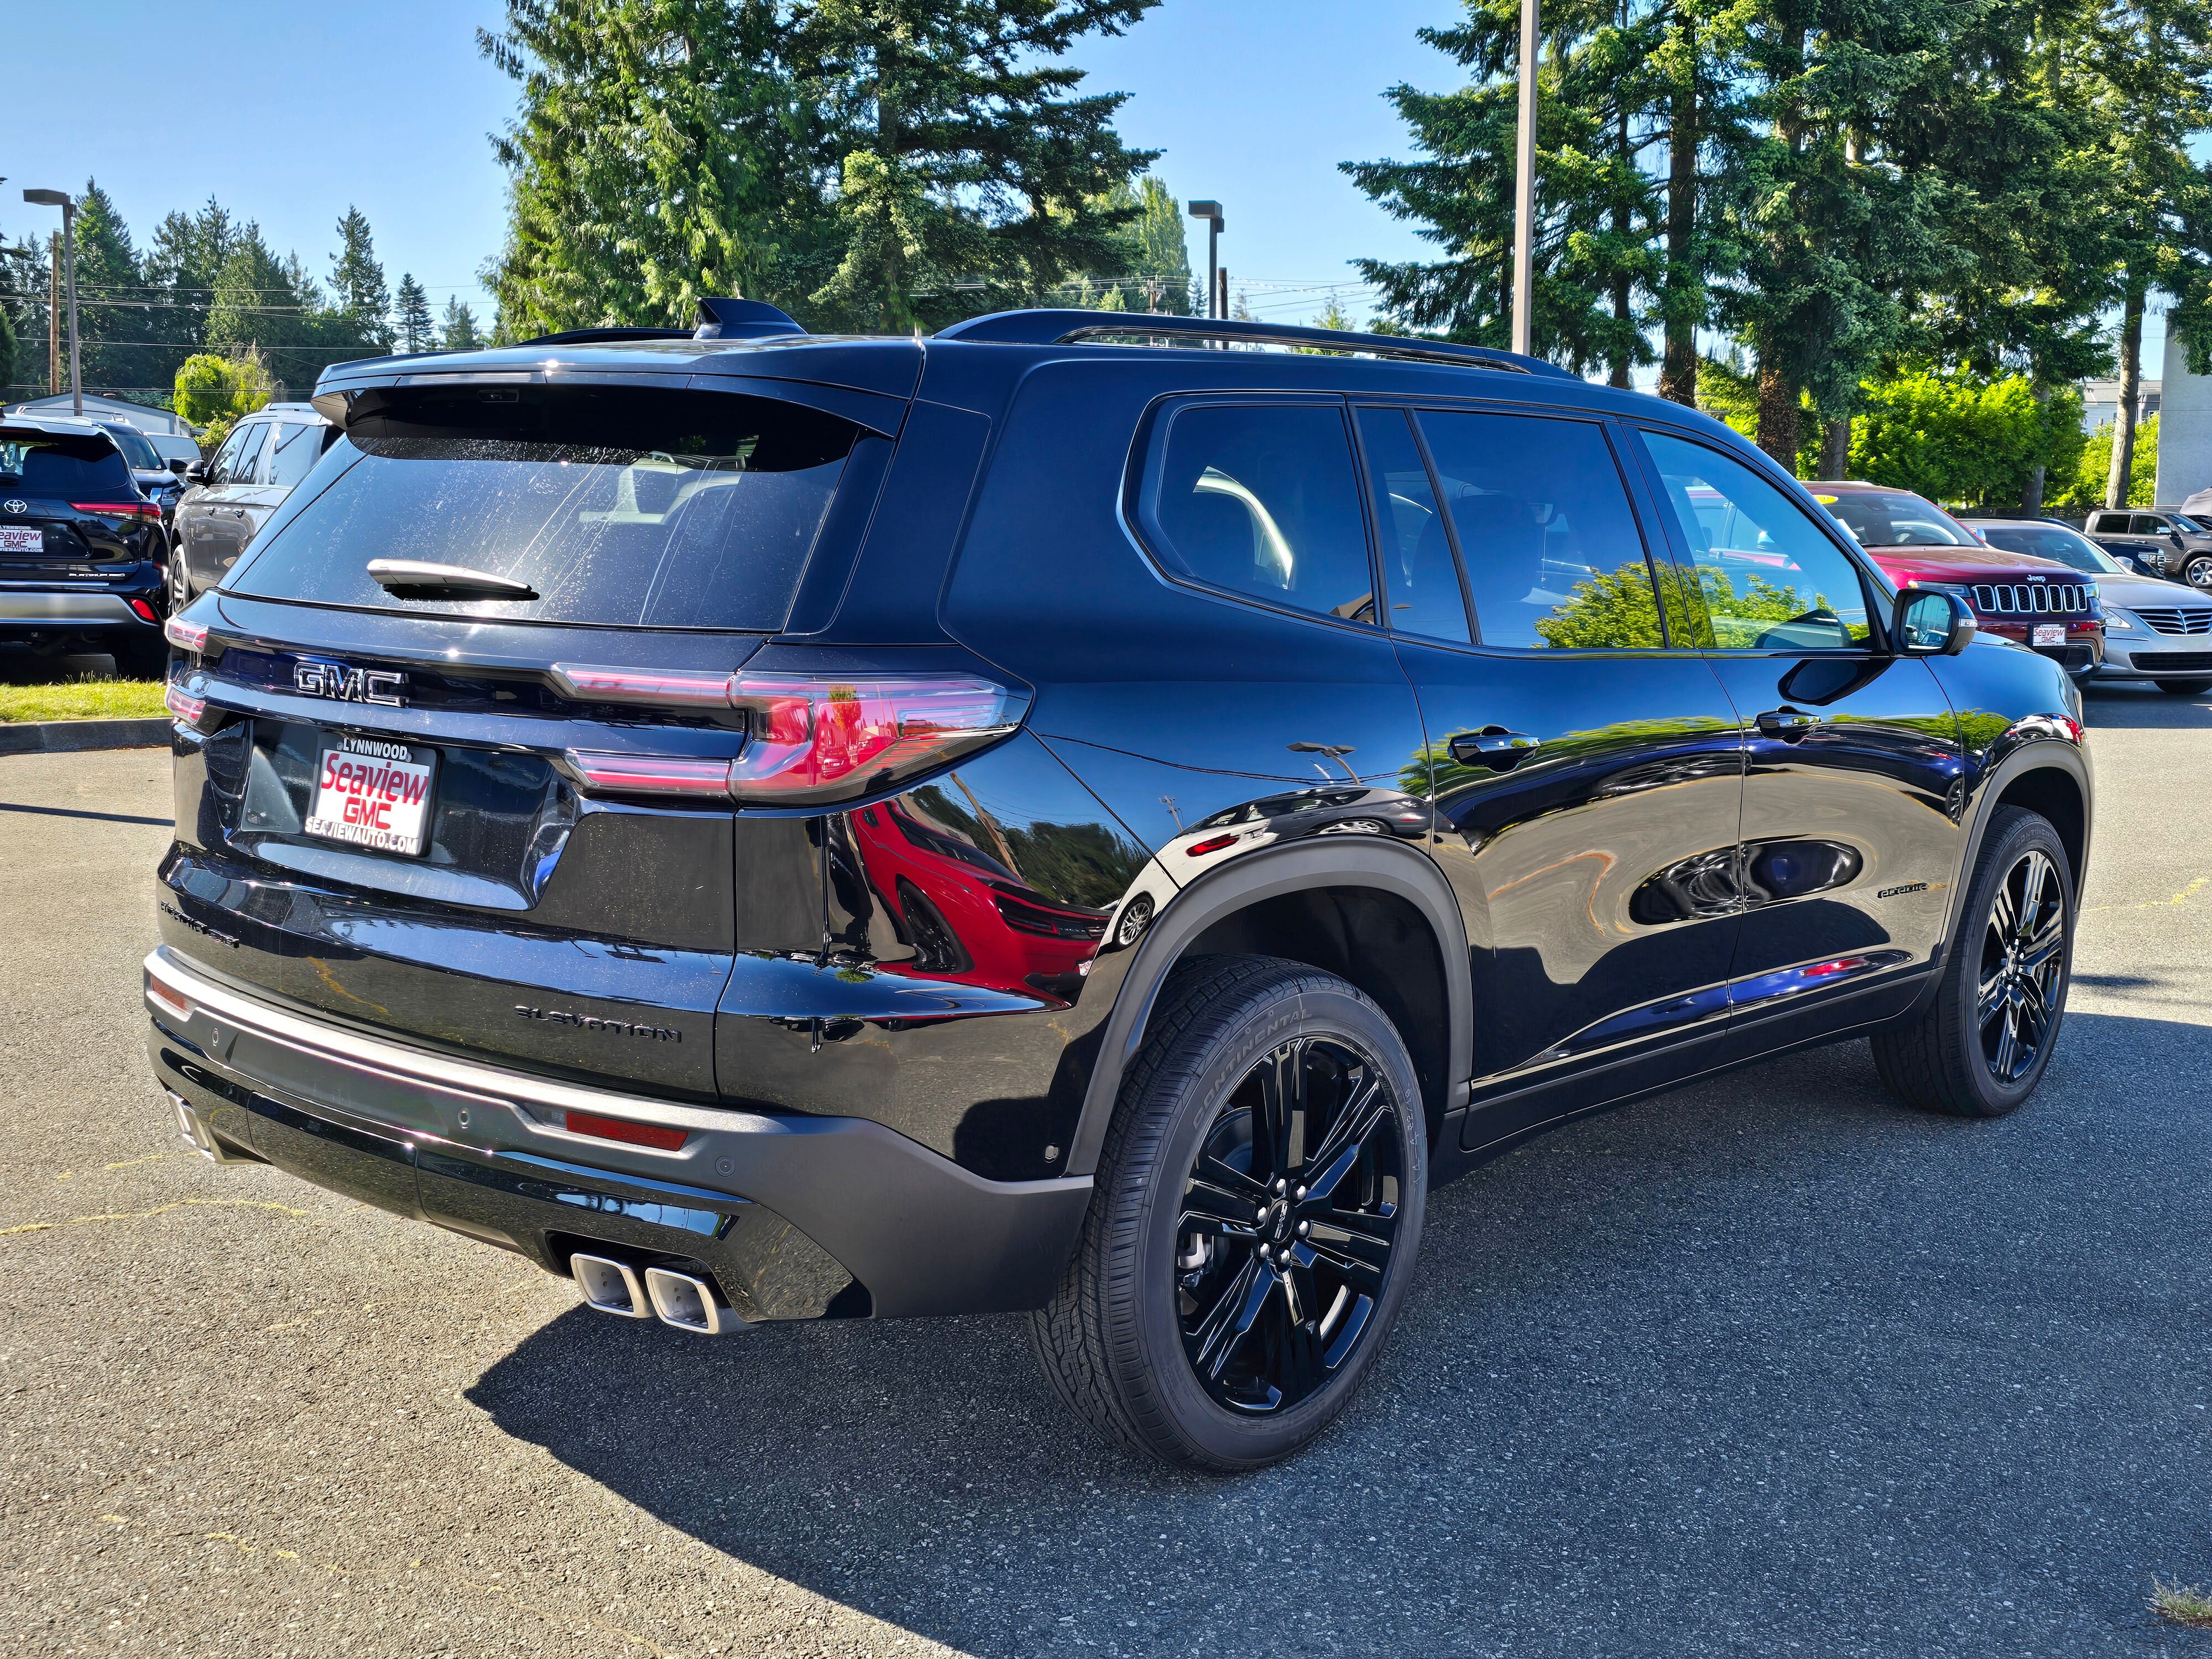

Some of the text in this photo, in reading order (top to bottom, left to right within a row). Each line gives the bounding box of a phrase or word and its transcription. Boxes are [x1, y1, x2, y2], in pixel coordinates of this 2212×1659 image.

[0, 530, 41, 541] eaview
[4, 540, 28, 549] GMC
[2027, 574, 2046, 582] Jeep
[2033, 628, 2064, 637] Seaview
[294, 662, 410, 708] GMC
[342, 738, 408, 760] LYNNWOOD
[321, 753, 430, 806] Seaview
[342, 796, 392, 830] GMC
[514, 1005, 682, 1043] ELEVATION
[1192, 1008, 1312, 1130] CONTINENTAL
